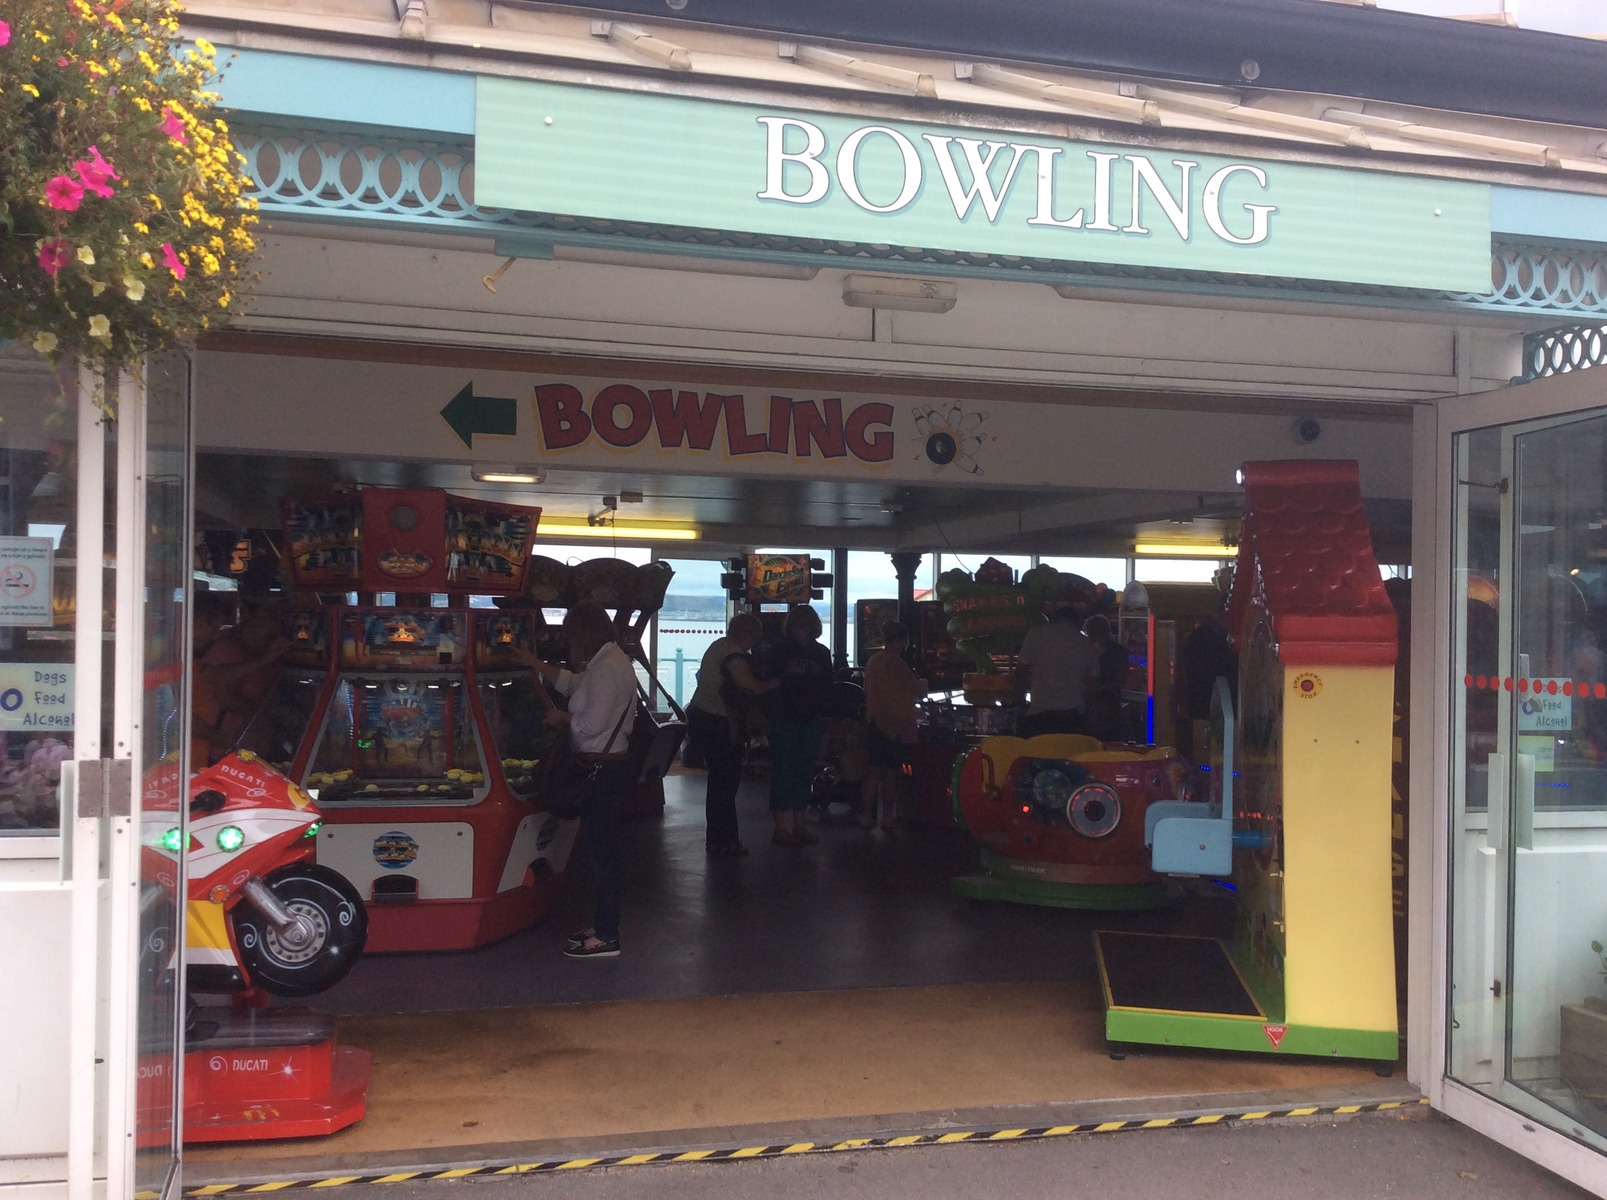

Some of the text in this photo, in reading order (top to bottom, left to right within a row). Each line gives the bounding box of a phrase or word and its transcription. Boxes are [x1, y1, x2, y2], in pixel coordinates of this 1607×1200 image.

[756, 115, 1278, 246] BOWLING
[532, 382, 895, 466] BOWLING
[34, 670, 67, 686] Dogs
[34, 691, 66, 705] Food
[1542, 700, 1562, 710] Food
[220, 764, 266, 788] DUCATI
[232, 1059, 269, 1071] DUCATI
